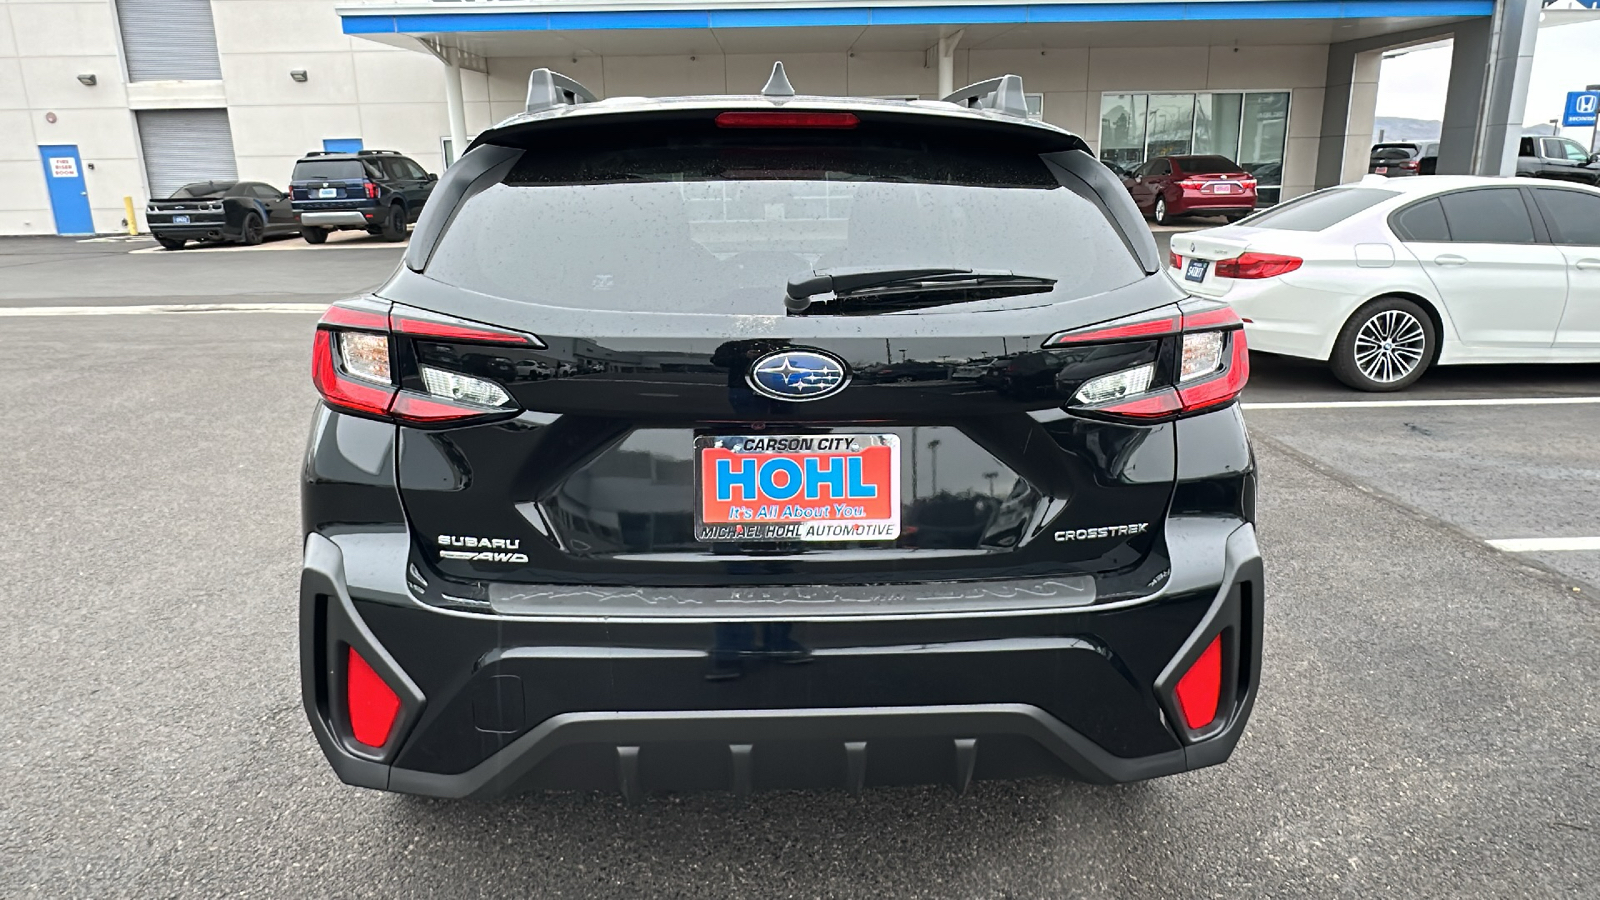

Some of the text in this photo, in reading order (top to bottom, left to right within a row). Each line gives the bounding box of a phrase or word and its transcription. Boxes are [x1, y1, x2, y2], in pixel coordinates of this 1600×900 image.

[743, 437, 855, 451] CARSON CITY
[716, 457, 877, 501] HOHL
[728, 503, 866, 519] It's All About You.
[700, 523, 894, 539] MICHAEL HOHL AUTOMOTIVE
[1054, 522, 1149, 542] CROSSTREK
[438, 535, 519, 549] SUBARU
[473, 551, 529, 563] AWD
